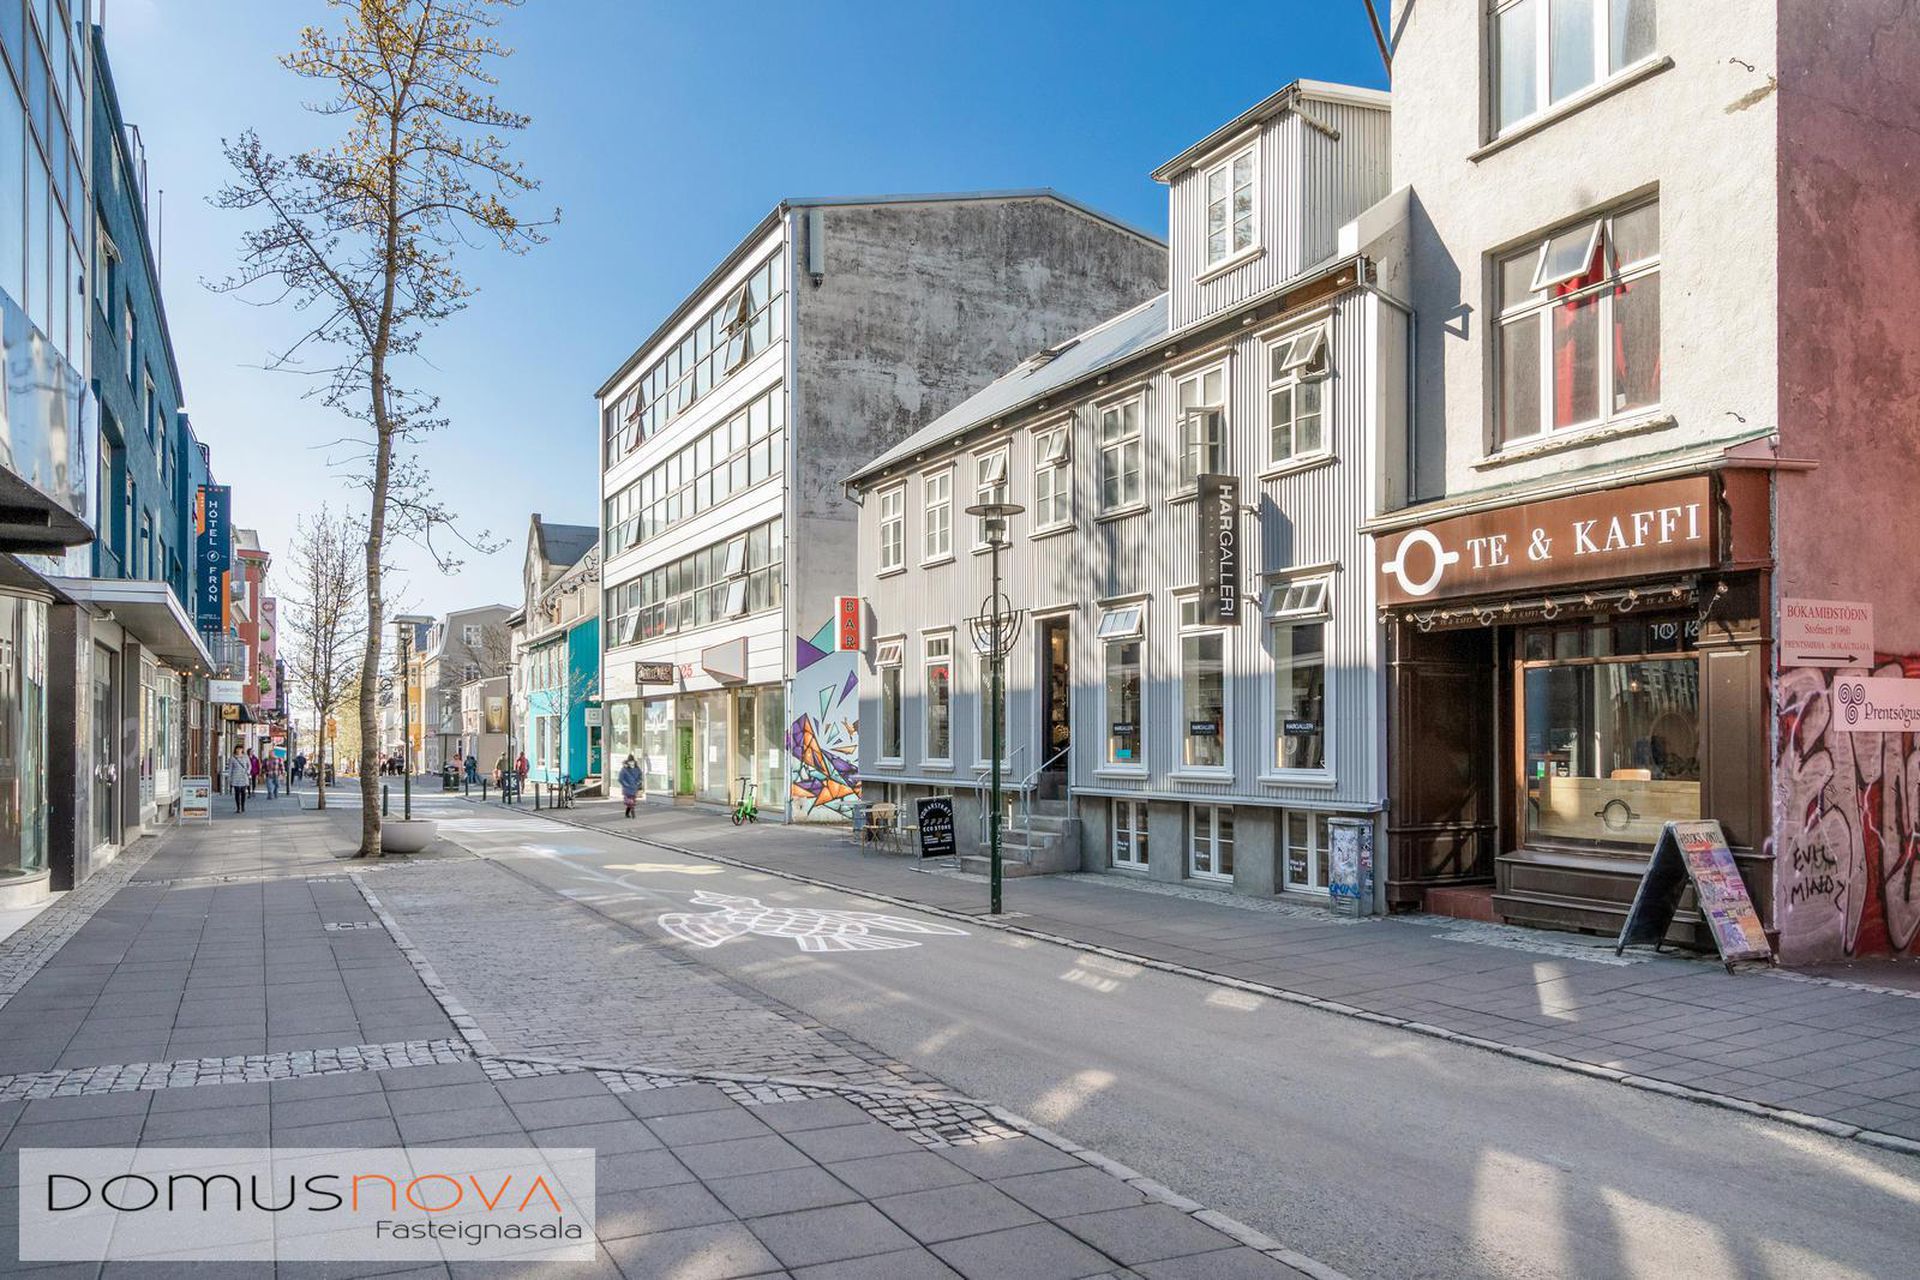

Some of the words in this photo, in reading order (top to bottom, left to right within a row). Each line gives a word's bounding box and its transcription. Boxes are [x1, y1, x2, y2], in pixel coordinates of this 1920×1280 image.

[1467, 533, 1510, 569] TE
[1528, 528, 1553, 561] &
[1572, 503, 1701, 556] KAFFI
[845, 600, 856, 648] BAR
